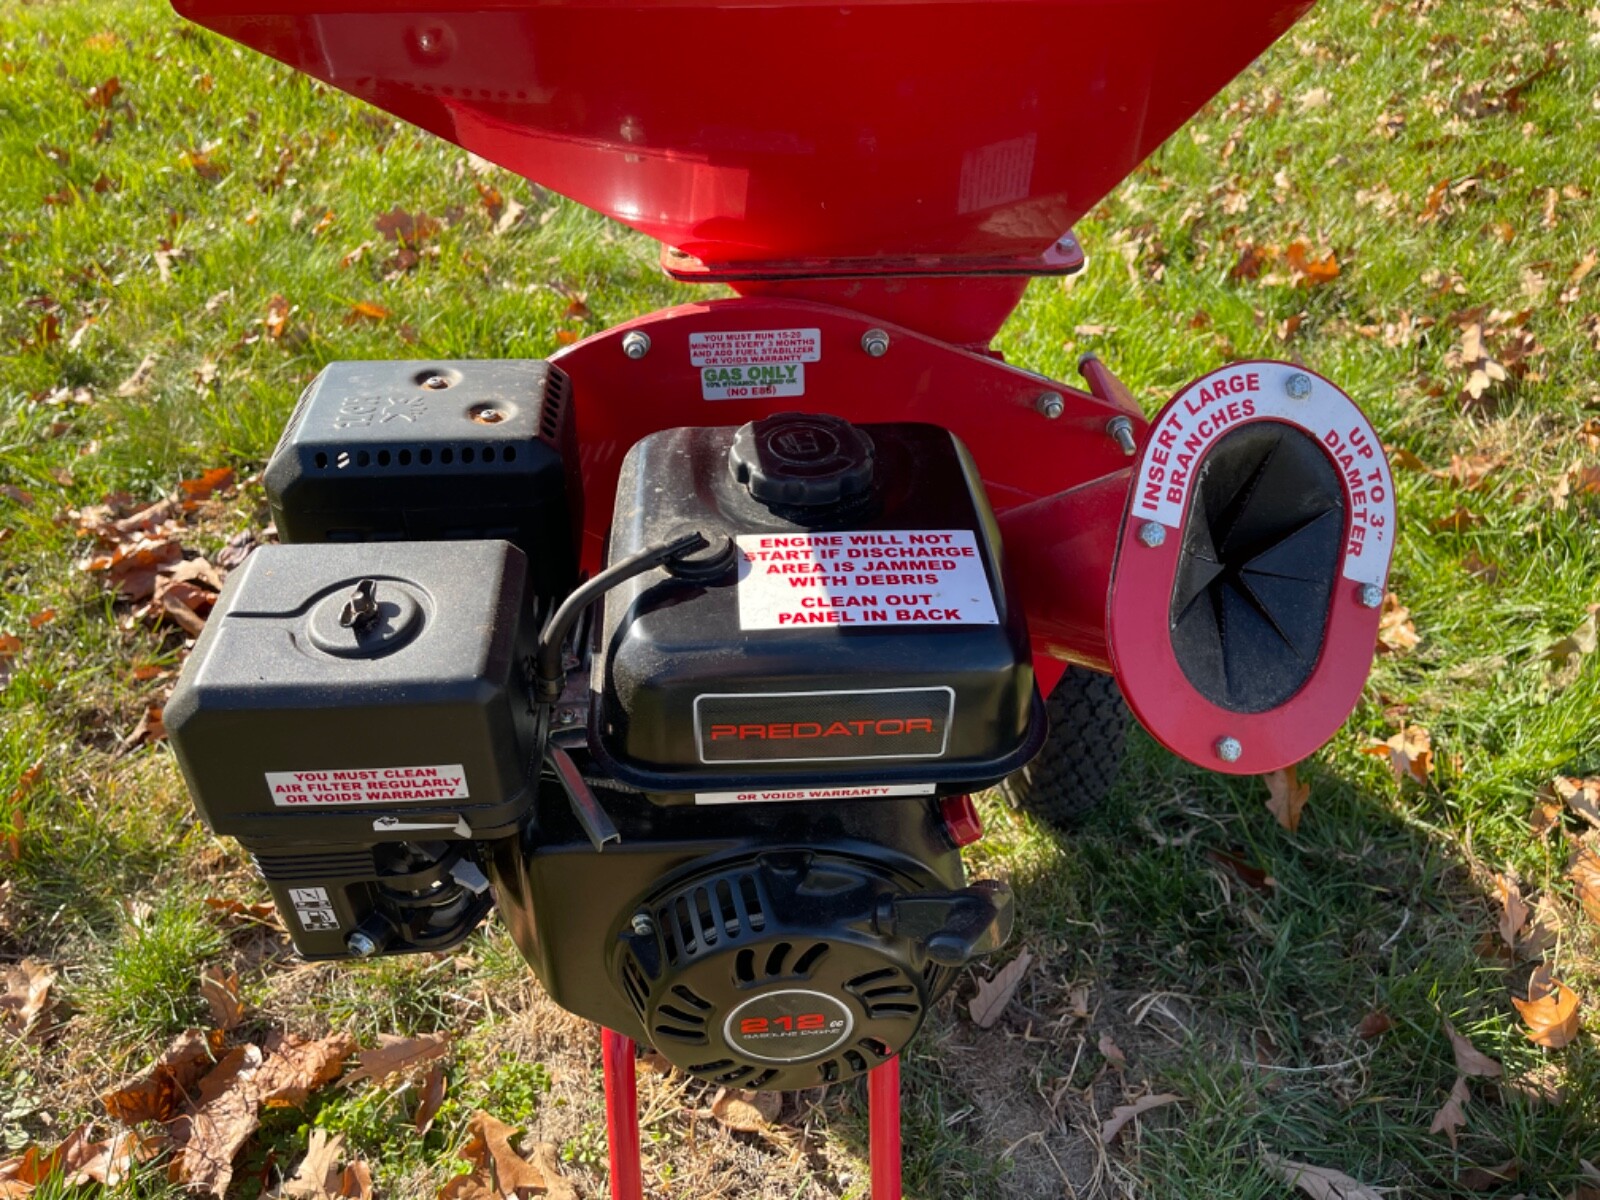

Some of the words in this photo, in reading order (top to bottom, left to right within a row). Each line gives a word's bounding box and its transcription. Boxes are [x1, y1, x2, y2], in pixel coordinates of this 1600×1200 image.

[691, 342, 733, 350] MINUTES
[735, 341, 765, 349] EVERY
[776, 338, 815, 346] MONTHS
[704, 334, 723, 342] YOU
[726, 333, 752, 341] MUST
[755, 332, 774, 340] RUN
[736, 348, 758, 356] FUEL
[761, 346, 814, 355] STABILIZER
[751, 355, 802, 363] WARRANTY
[704, 367, 742, 382] GAS
[747, 365, 798, 380] ONLY
[726, 387, 748, 397] (NO
[1141, 412, 1183, 511] INSERT
[1183, 373, 1260, 416] LARGE
[1166, 398, 1256, 505] BRANCHES
[1349, 426, 1374, 460] UP
[1367, 467, 1385, 504] TO
[1323, 429, 1368, 558] DIAMETER
[760, 536, 844, 548] ENGINE
[849, 534, 902, 545] WILL
[909, 534, 953, 545] NOT
[743, 550, 813, 562] START
[820, 549, 840, 560] IF
[847, 546, 975, 558] DISCHARGE
[766, 560, 830, 575] AREA
[833, 561, 855, 572] IS
[862, 560, 957, 572] JAMMED
[788, 576, 848, 588] WITH
[855, 574, 939, 586] DEBRIS
[801, 595, 878, 609] CLEAN
[885, 594, 933, 606] OUT
[778, 610, 856, 624] PANEL
[863, 610, 888, 621] IN
[896, 609, 962, 621] BACK
[710, 718, 934, 740] PREDATOR
[294, 772, 328, 782] YOU
[333, 770, 379, 780] MUST
[383, 768, 438, 779] CLEAN
[275, 784, 304, 793] AIR
[307, 781, 363, 792] FILTER
[366, 777, 462, 790] REGULARLY
[286, 794, 309, 803] OR
[313, 791, 363, 802] VOIDS
[365, 788, 457, 800] WARRANTY
[737, 793, 757, 801] OR
[761, 791, 805, 800] VOIDS
[809, 787, 890, 799] WARRANTY
[741, 1013, 825, 1034] 212
